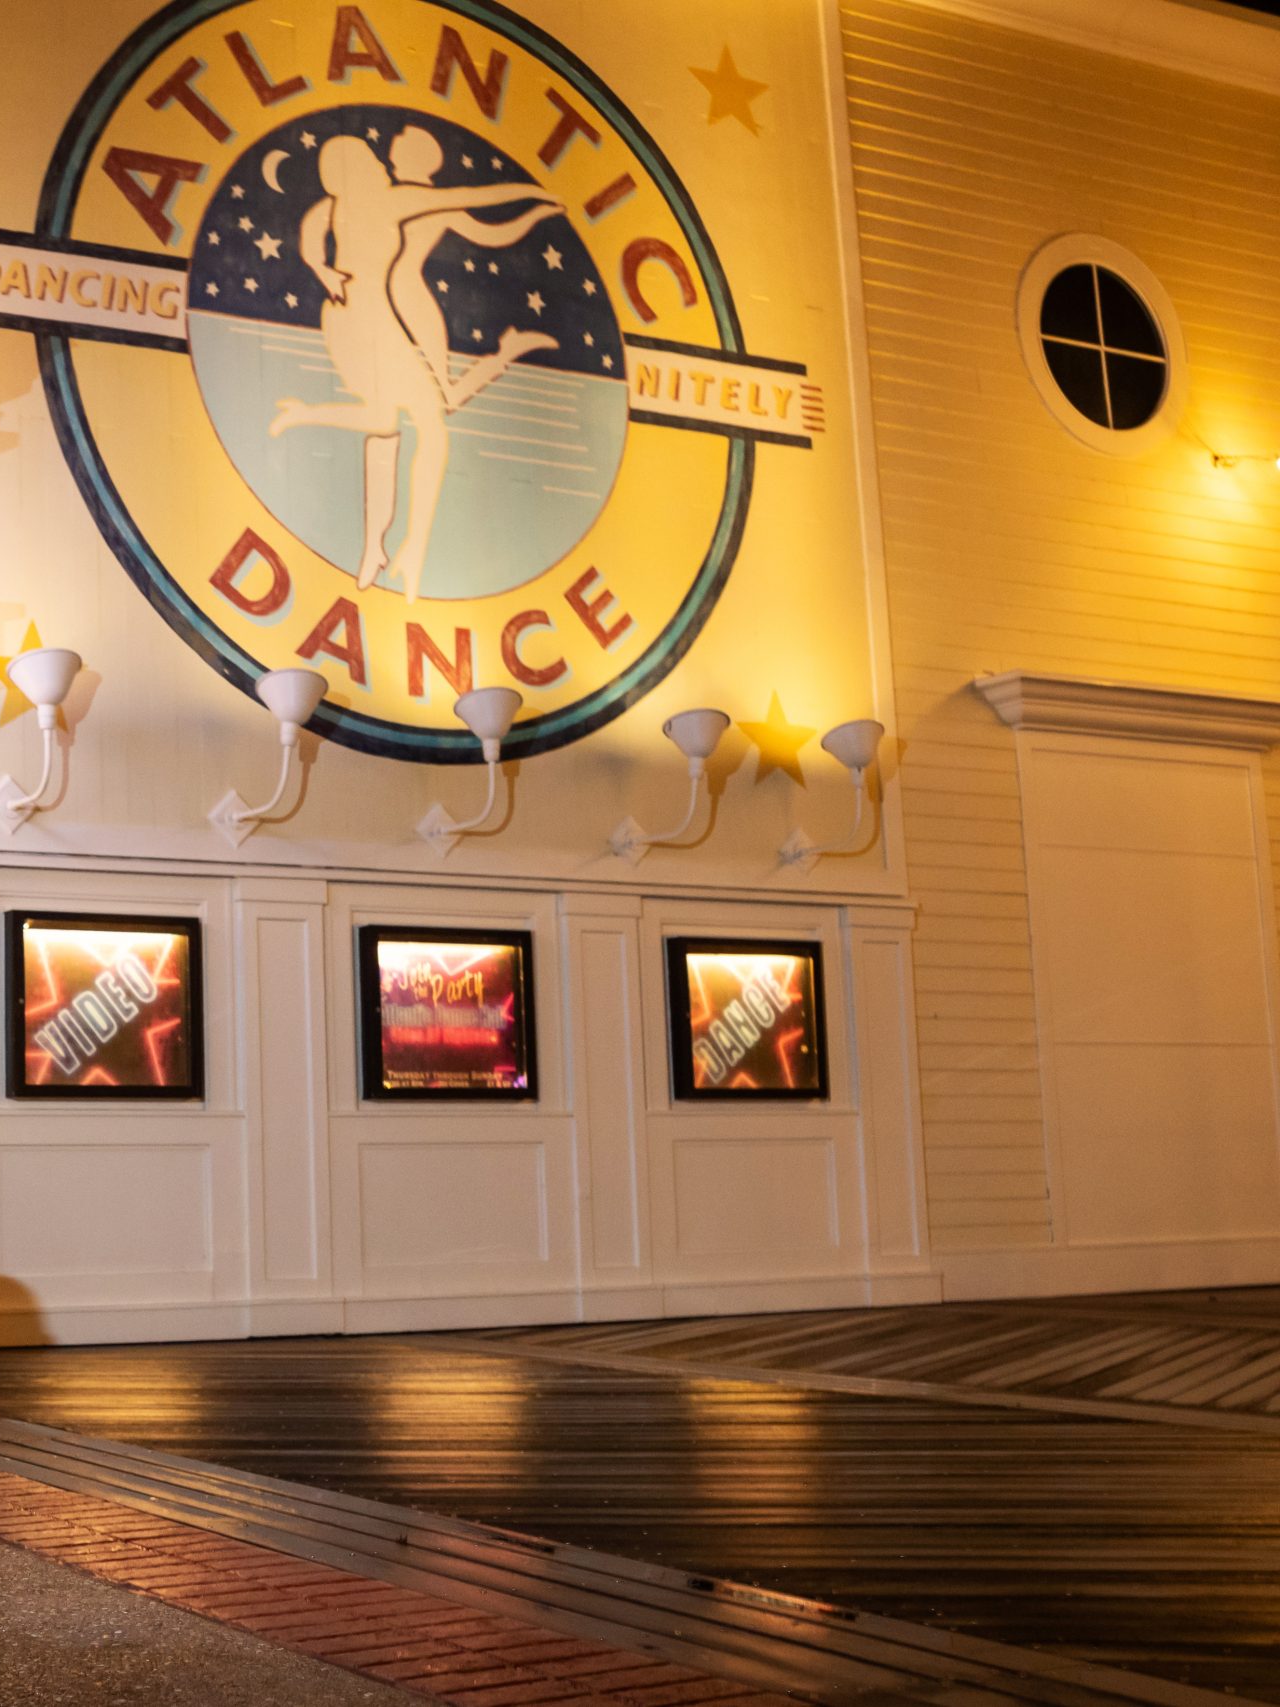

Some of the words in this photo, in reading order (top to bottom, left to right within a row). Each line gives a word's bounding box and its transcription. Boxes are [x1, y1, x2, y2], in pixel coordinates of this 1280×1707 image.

[101, 5, 699, 324] ATLANTIC
[636, 363, 793, 419] NITELY
[208, 526, 634, 698] DANCE
[33, 951, 158, 1075] VIDEO
[692, 966, 792, 1085] DANCE
